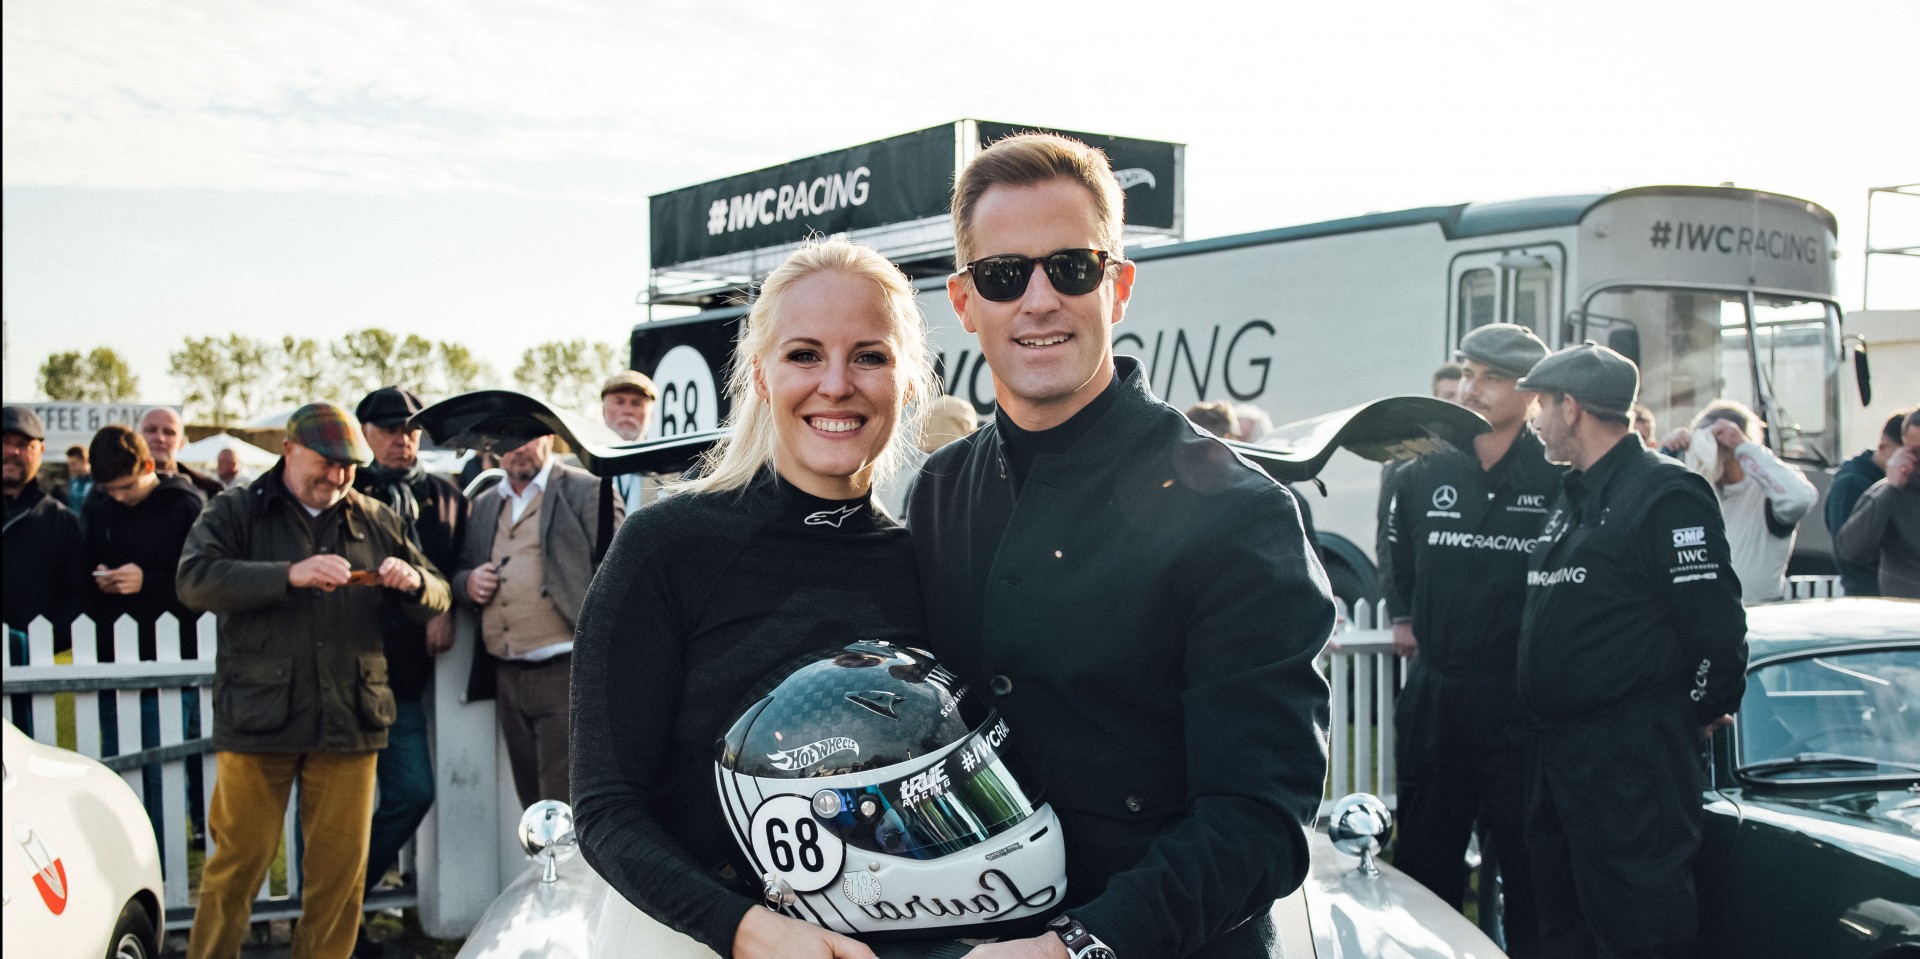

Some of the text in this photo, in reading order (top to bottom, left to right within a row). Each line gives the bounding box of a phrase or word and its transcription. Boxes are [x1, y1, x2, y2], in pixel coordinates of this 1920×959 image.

[661, 381, 698, 437] 68
[1672, 526, 1706, 547] OMP
[1677, 548, 1708, 564] IWC
[765, 816, 825, 873] 68
